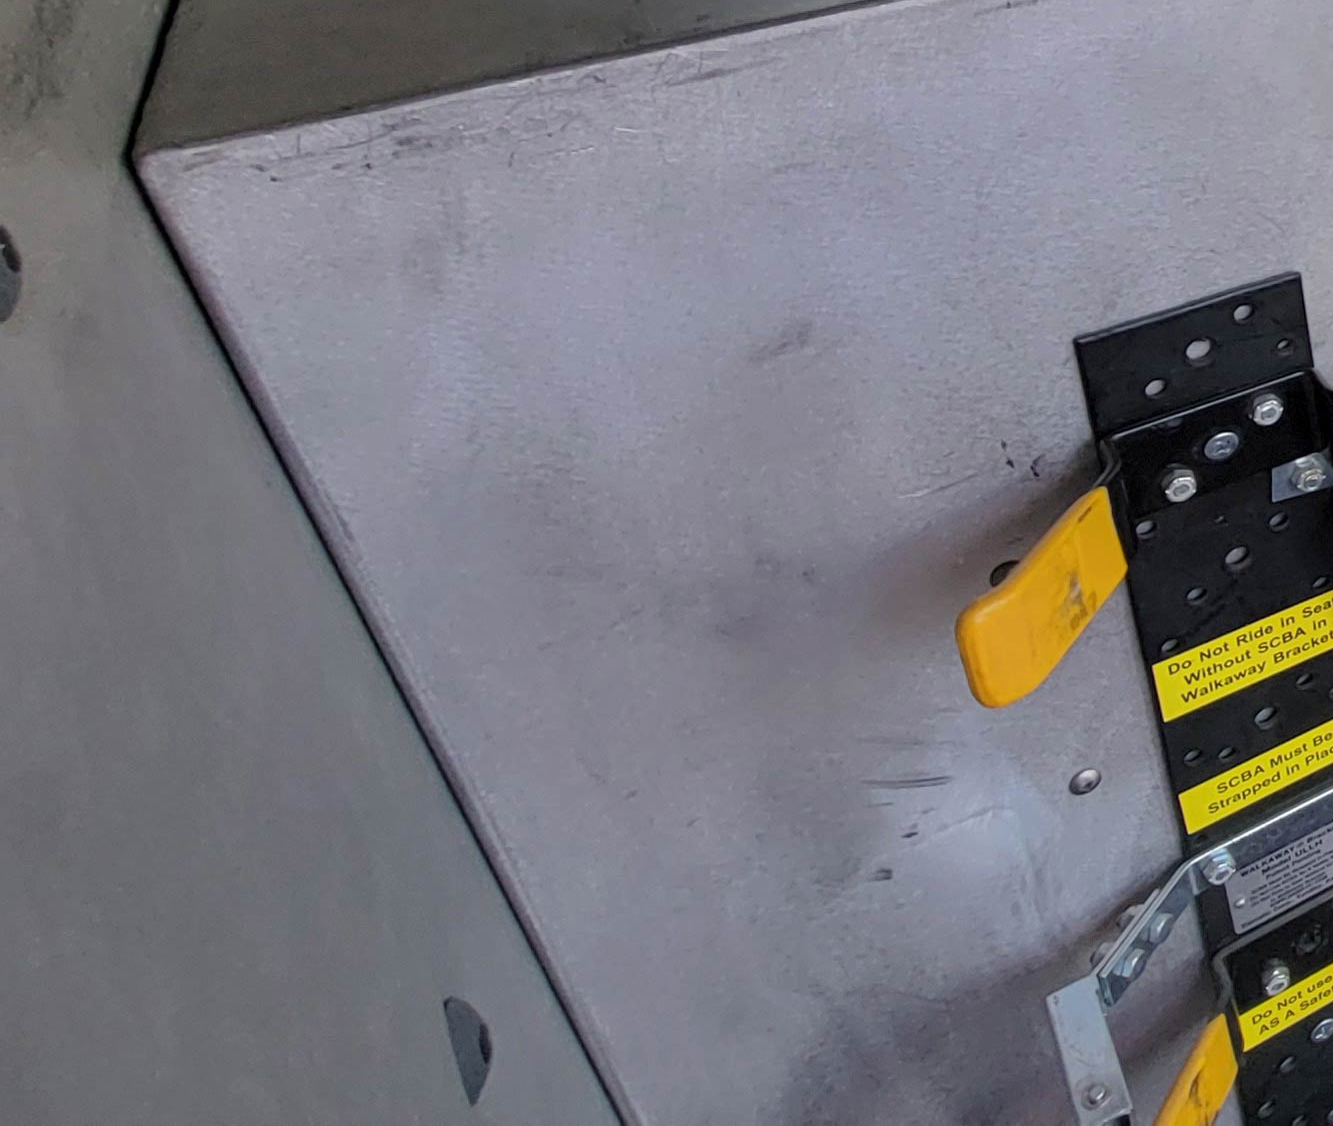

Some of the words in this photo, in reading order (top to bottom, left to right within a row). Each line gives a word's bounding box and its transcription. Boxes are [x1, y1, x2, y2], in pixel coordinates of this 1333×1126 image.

[1167, 660, 1192, 675] Do
[1199, 641, 1230, 662] Not
[1236, 624, 1274, 647] Ride
[1184, 650, 1252, 685] Without
[1257, 627, 1307, 654] SCBA
[1181, 660, 1267, 704] Walkaway
[1216, 764, 1265, 794] SCBA
[1270, 742, 1309, 766] Must
[1313, 731, 1333, 746] Be
[1208, 773, 1281, 814] Strapped
[1252, 1009, 1273, 1025] Do
[1276, 989, 1302, 1012] Not
[1307, 975, 1333, 996] use
[1258, 1017, 1280, 1036] AS
[1285, 1009, 1295, 1022] A
